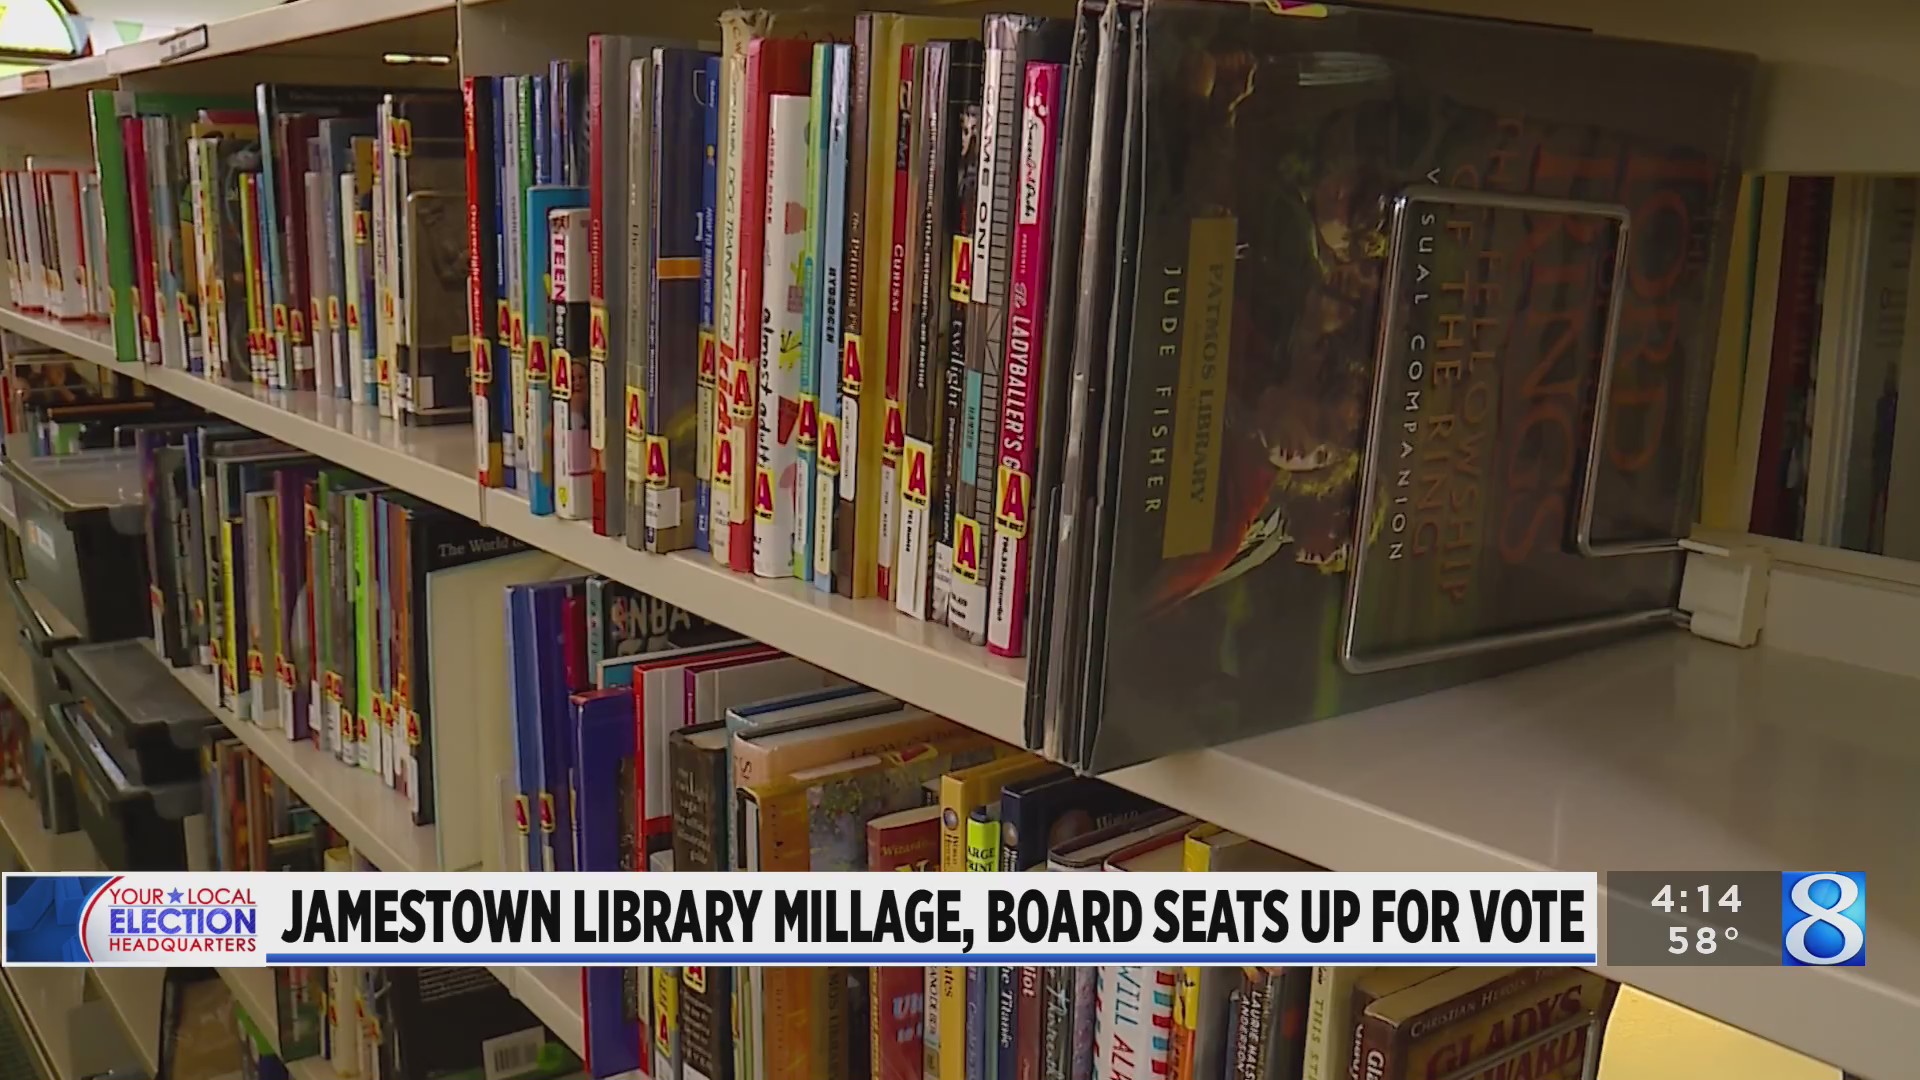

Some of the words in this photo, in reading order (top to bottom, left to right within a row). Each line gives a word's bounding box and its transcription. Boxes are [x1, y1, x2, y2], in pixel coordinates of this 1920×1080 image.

[982, 84, 995, 188] GAME
[705, 207, 714, 231] HOW
[726, 165, 736, 214] DOG
[976, 201, 989, 260] ON!
[553, 234, 568, 302] TEEN
[721, 217, 735, 301] TRAINING
[891, 244, 904, 312] CUBISM
[1415, 167, 1442, 305] VSUAL
[720, 303, 732, 340] FOR
[825, 267, 836, 343] HYDROGEN
[1158, 265, 1184, 357] JUDE
[1201, 263, 1224, 381] PATMOS
[1433, 270, 1469, 386] THE
[1609, 152, 1713, 472] LORD
[758, 308, 773, 395] almost
[1003, 315, 1031, 452] LADYBALLER'S
[1144, 384, 1172, 513] FISHER
[1190, 387, 1214, 504] LIBRARY
[1388, 333, 1426, 561] COMPANION
[1439, 249, 1499, 604] FELLOWSHIP
[1412, 414, 1456, 558] RING
[438, 542, 465, 557] The
[469, 536, 509, 553] World
[630, 596, 691, 640] NBA
[1114, 966, 1142, 1026] WILL
[1235, 995, 1251, 1073] ANDERSON
[1247, 990, 1263, 1042] LAURIE
[1311, 999, 1324, 1044] THIS
[1409, 1002, 1476, 1038] CHRISTIAN
[1425, 984, 1583, 1078] GLADYS
